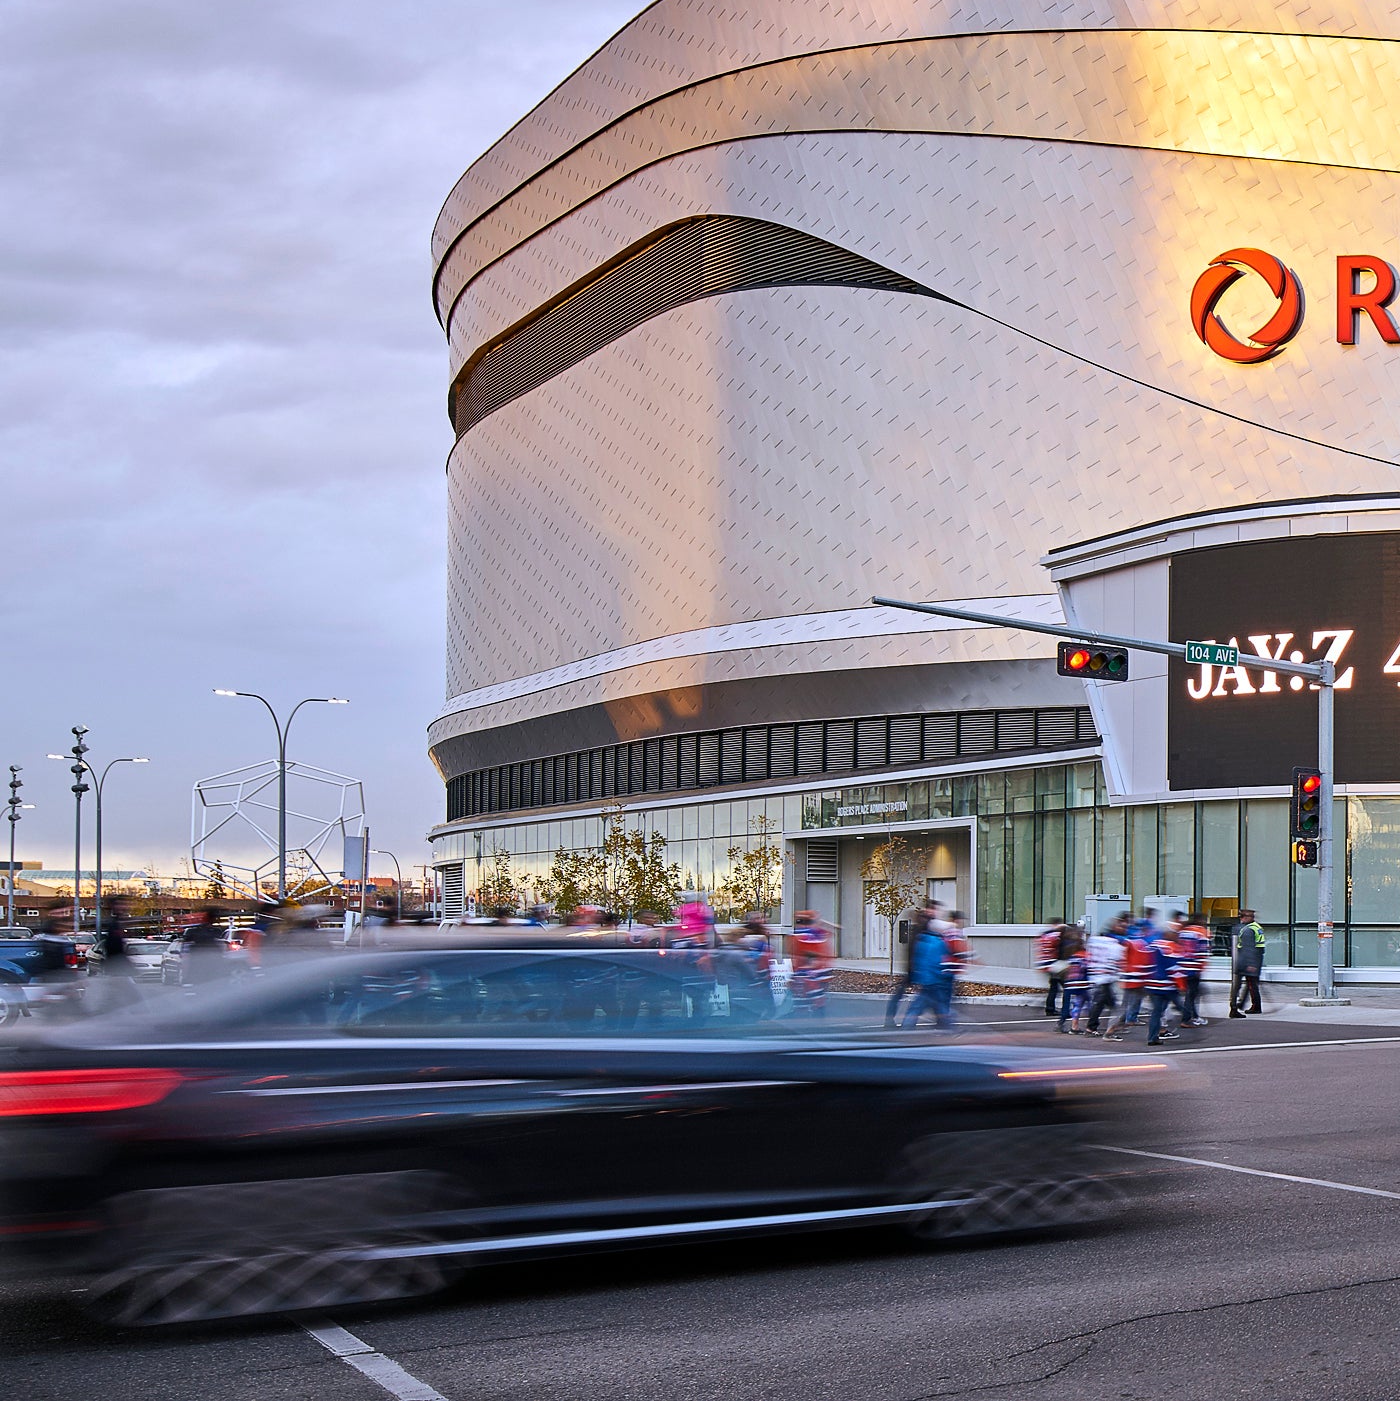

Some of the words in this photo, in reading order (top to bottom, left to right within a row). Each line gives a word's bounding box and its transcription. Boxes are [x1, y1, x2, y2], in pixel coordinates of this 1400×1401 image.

[1190, 646, 1210, 660] 104
[1215, 648, 1235, 663] AVE
[837, 805, 855, 817] ROGERS
[855, 804, 870, 815] PLACE
[870, 801, 908, 814] ADMINISTRATION
